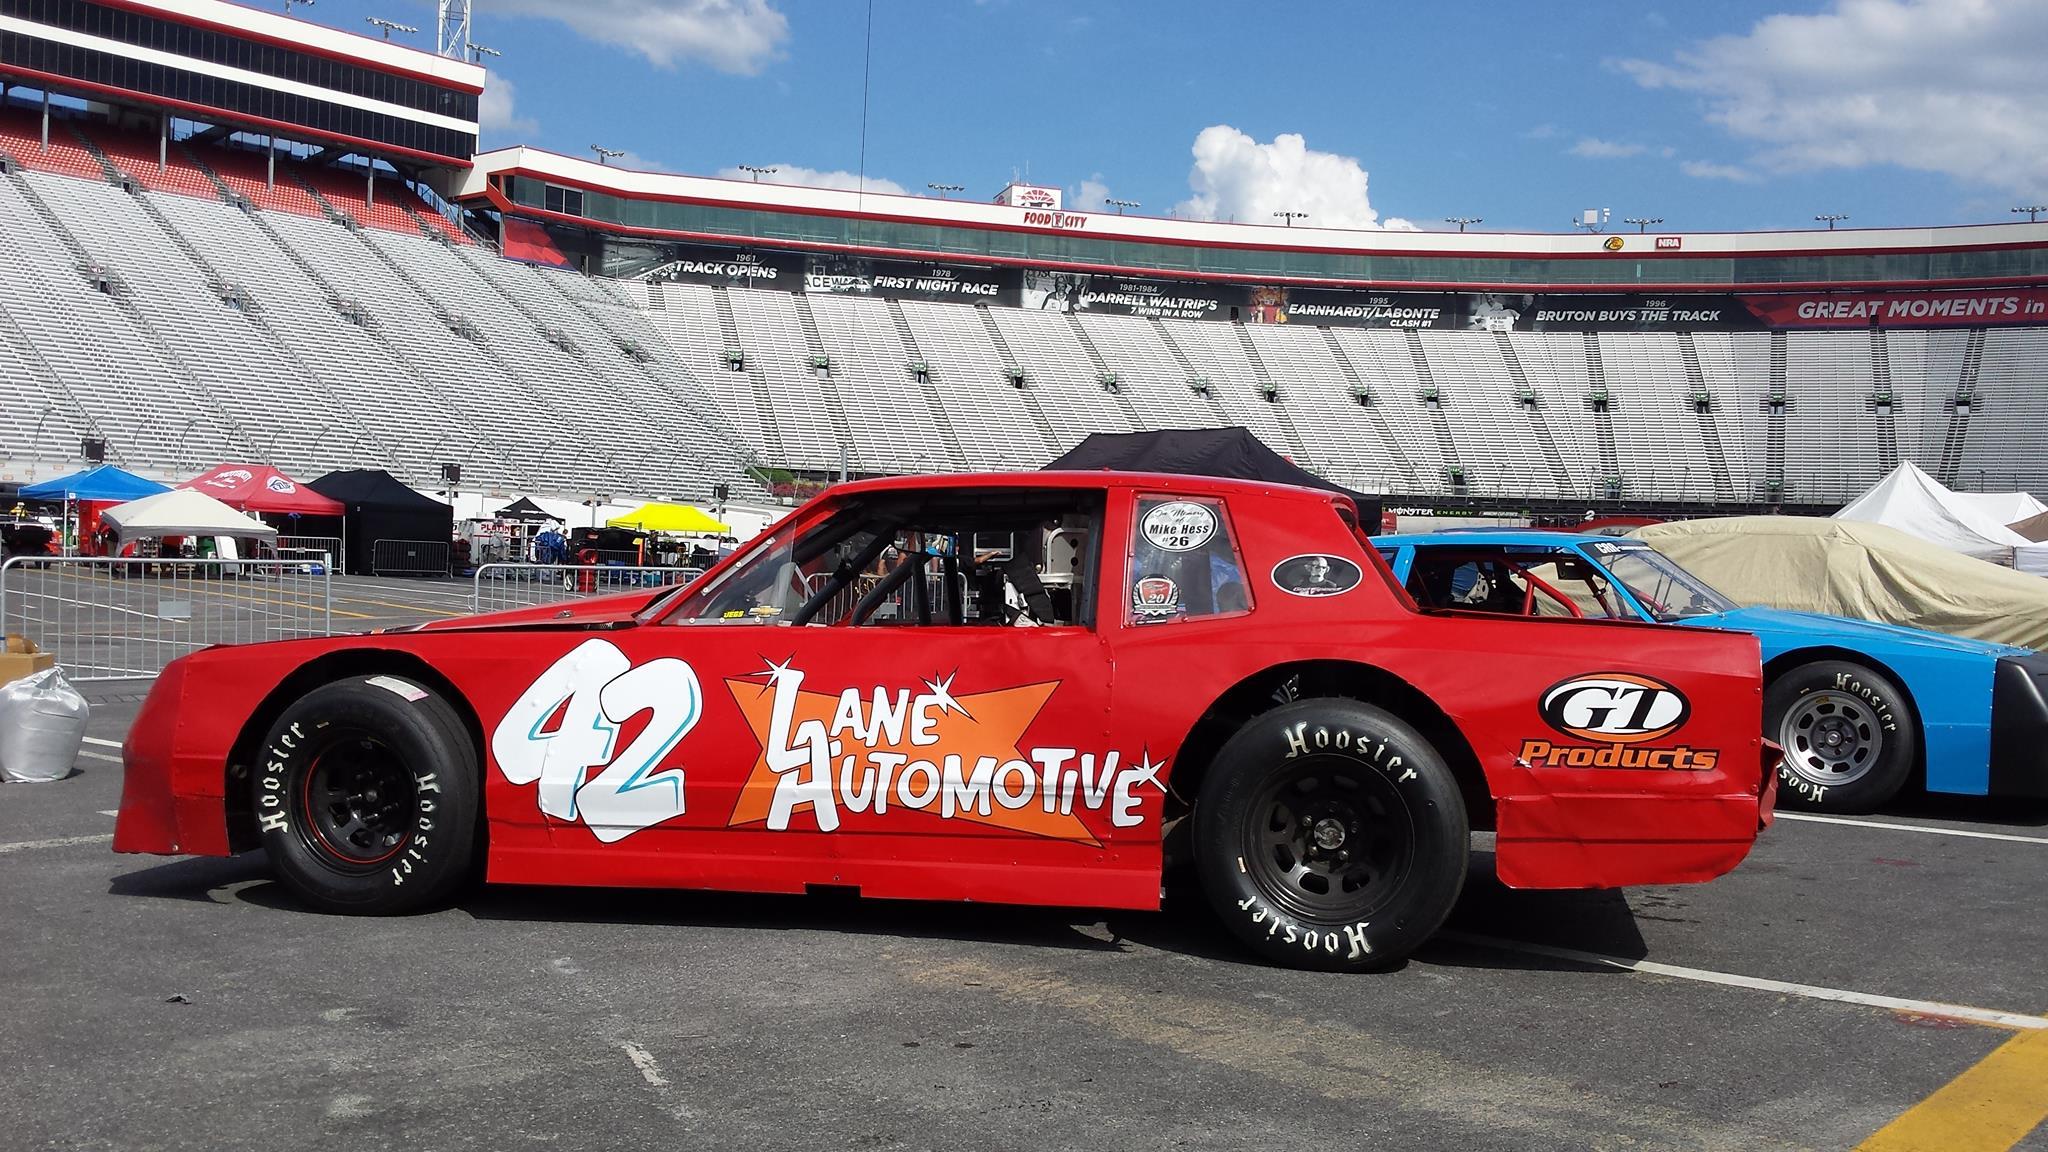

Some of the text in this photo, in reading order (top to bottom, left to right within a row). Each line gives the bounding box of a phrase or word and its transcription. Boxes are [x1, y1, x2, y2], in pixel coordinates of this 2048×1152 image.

[1024, 212, 1051, 225] FOOD
[1065, 215, 1087, 228] CITY
[1658, 238, 1680, 247] NRA
[736, 254, 756, 262] 1961
[675, 260, 777, 279] TRACK OPENS
[932, 269, 951, 277] 1978
[873, 275, 999, 296] FIRST NIGHT RACE
[1119, 283, 1158, 293] 1981-1984
[1087, 293, 1218, 311] DARRELL WALTRIP'S
[1369, 297, 1389, 305] 1995
[1798, 297, 2045, 318] GREAT MOMENTS in
[1137, 307, 1161, 316] WINS
[1162, 309, 1172, 317] IN
[1172, 309, 1180, 317] A
[1181, 310, 1204, 318] ROW
[1536, 311, 1721, 321] BRUTON BUYS THE TRACK
[1390, 319, 1432, 328] CLASH #1
[1388, 507, 1434, 516] MONSTER
[1149, 524, 1209, 534] Mike Hess
[1147, 593, 1165, 603] 20
[1832, 672, 1897, 732] Hoosier
[765, 667, 940, 774] LANE
[491, 638, 703, 844] 42
[1284, 721, 1417, 783] Hoosier
[1516, 739, 1719, 770] Products
[257, 721, 305, 833] Hoosier
[766, 721, 1147, 833] AUTOMOTIVE
[1776, 761, 1829, 802] Hoosi
[392, 771, 442, 886] Hoosier
[1238, 895, 1373, 959] Hoosier
